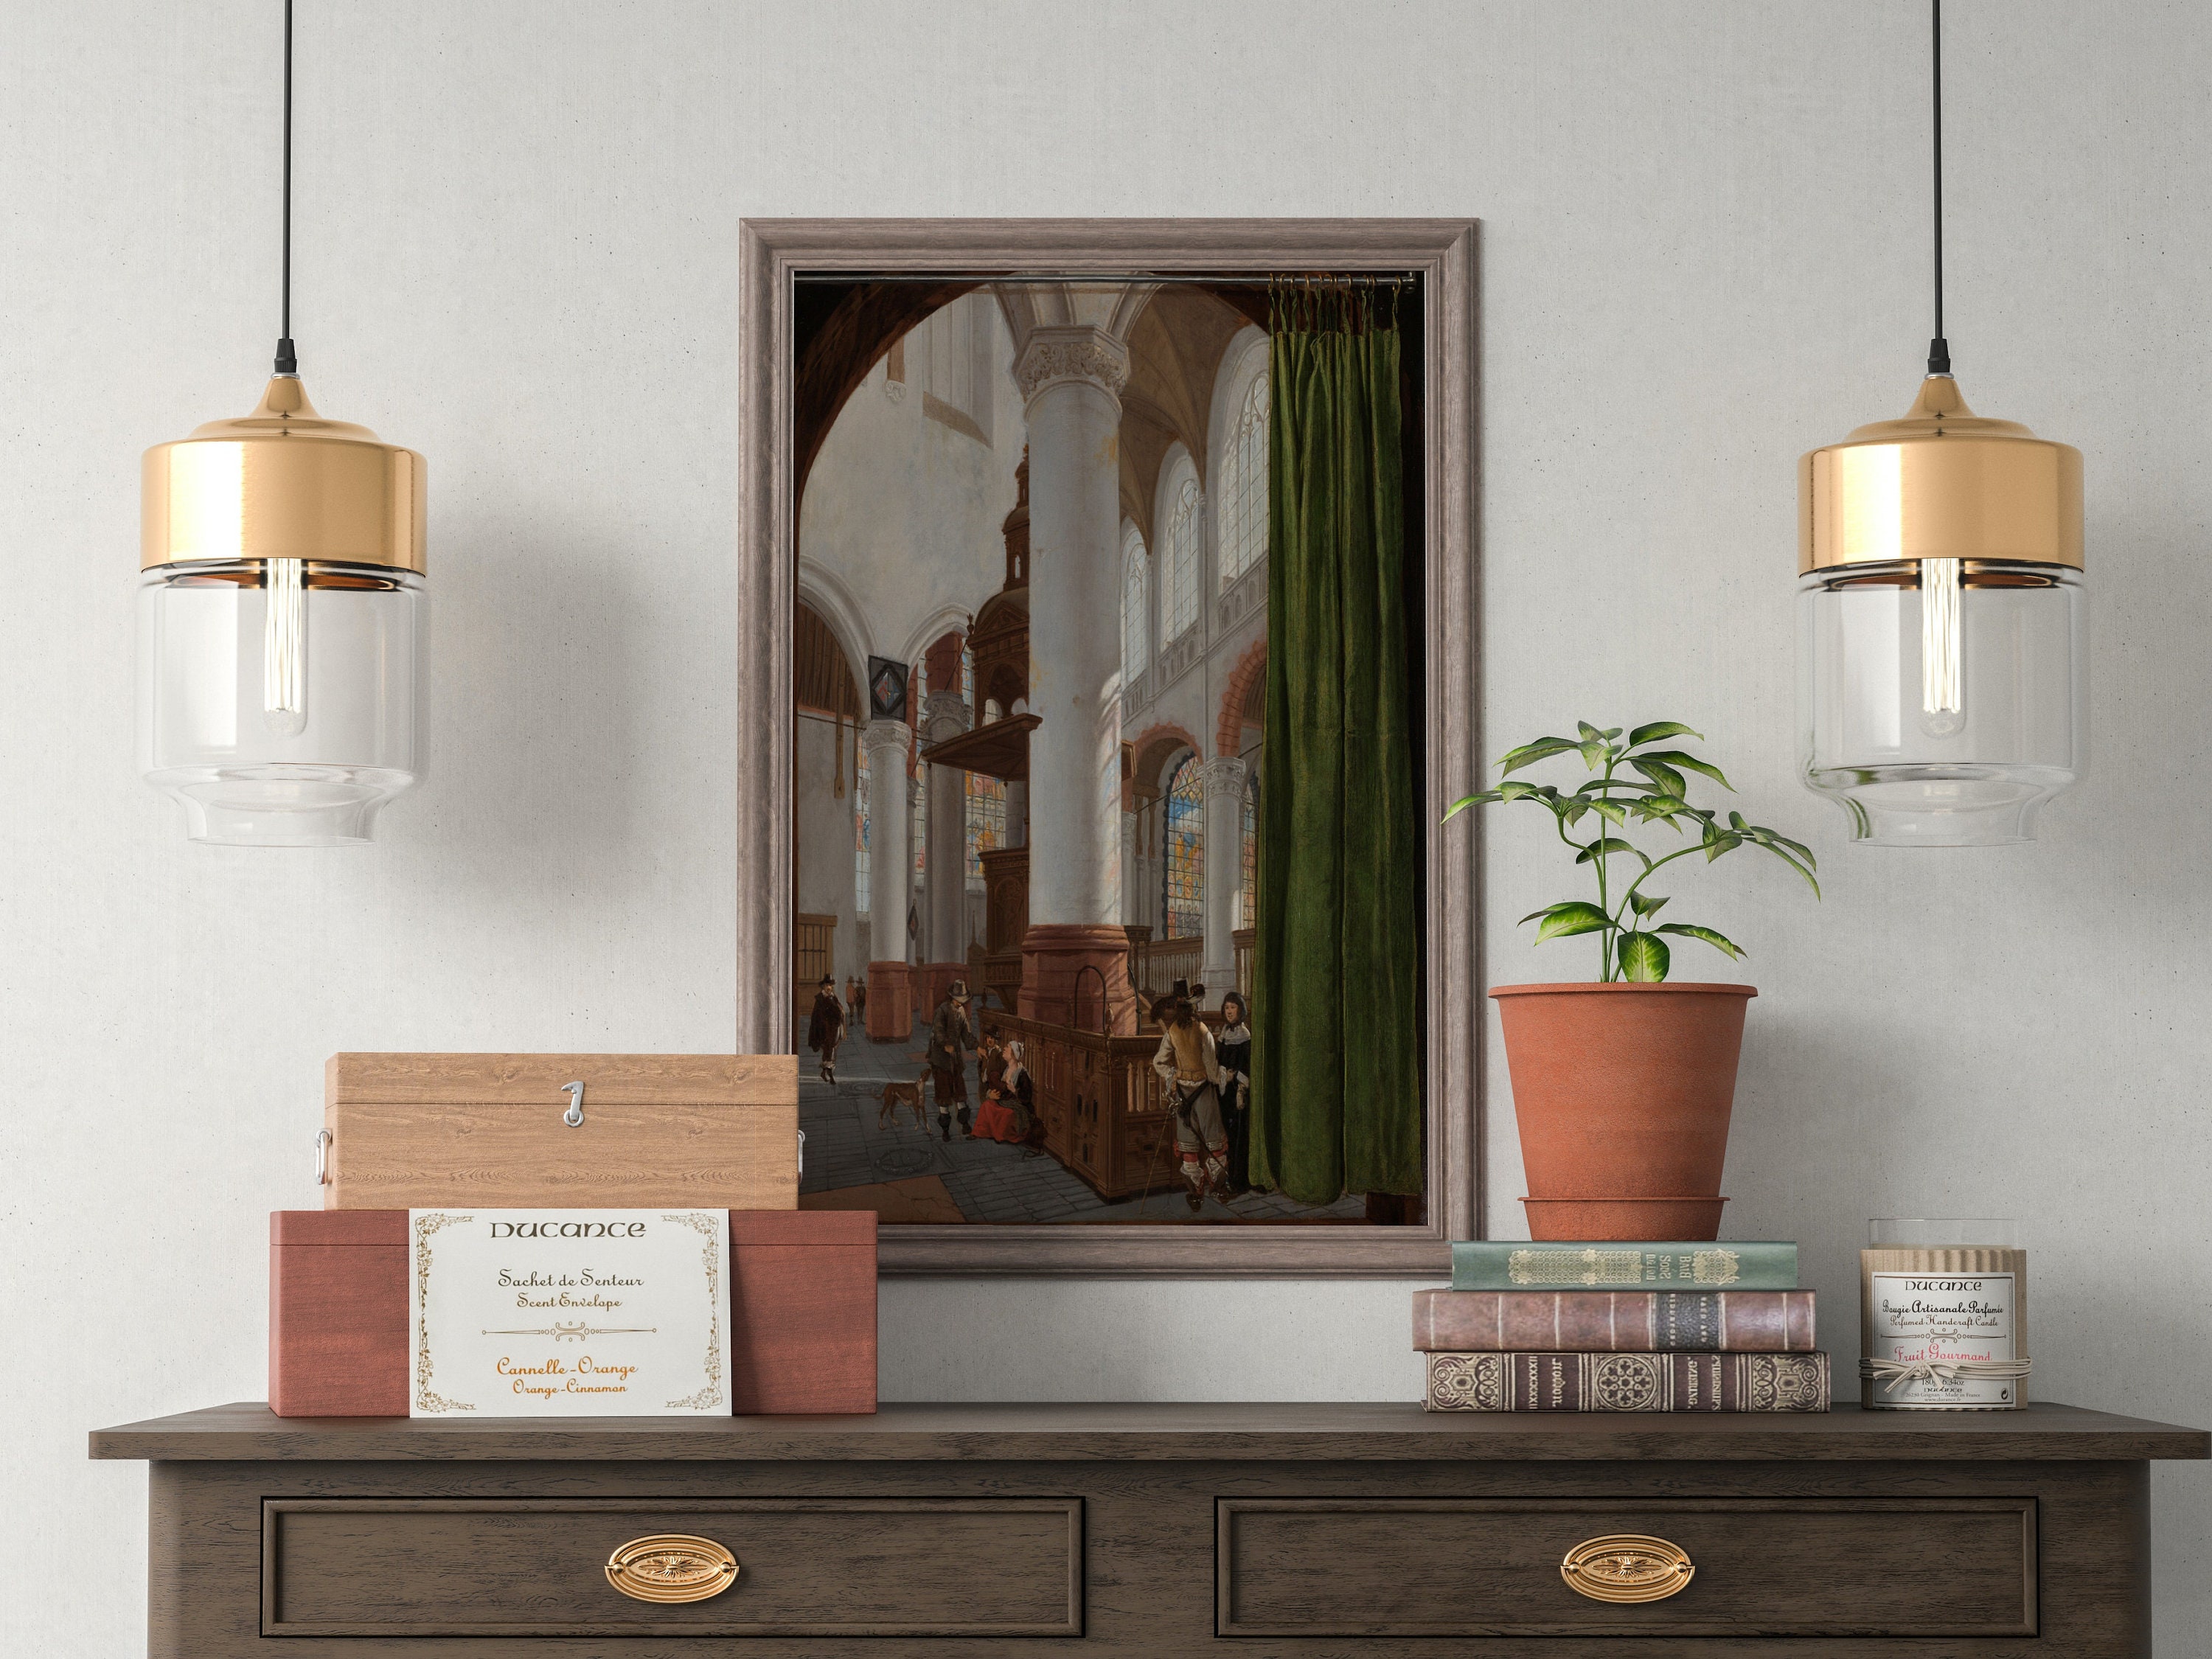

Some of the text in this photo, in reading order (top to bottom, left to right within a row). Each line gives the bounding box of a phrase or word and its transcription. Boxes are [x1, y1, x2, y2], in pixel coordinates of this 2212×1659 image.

[498, 1268, 644, 1287] Sachet de Senteur
[517, 1292, 622, 1312] Scent Envelope
[1882, 1299, 1910, 1318] Bougie
[1912, 1300, 1968, 1313] Artisanale
[1890, 1314, 1998, 1329] Perfumed Handcraft Candle
[1894, 1343, 1993, 1362] Fruit Gourmand
